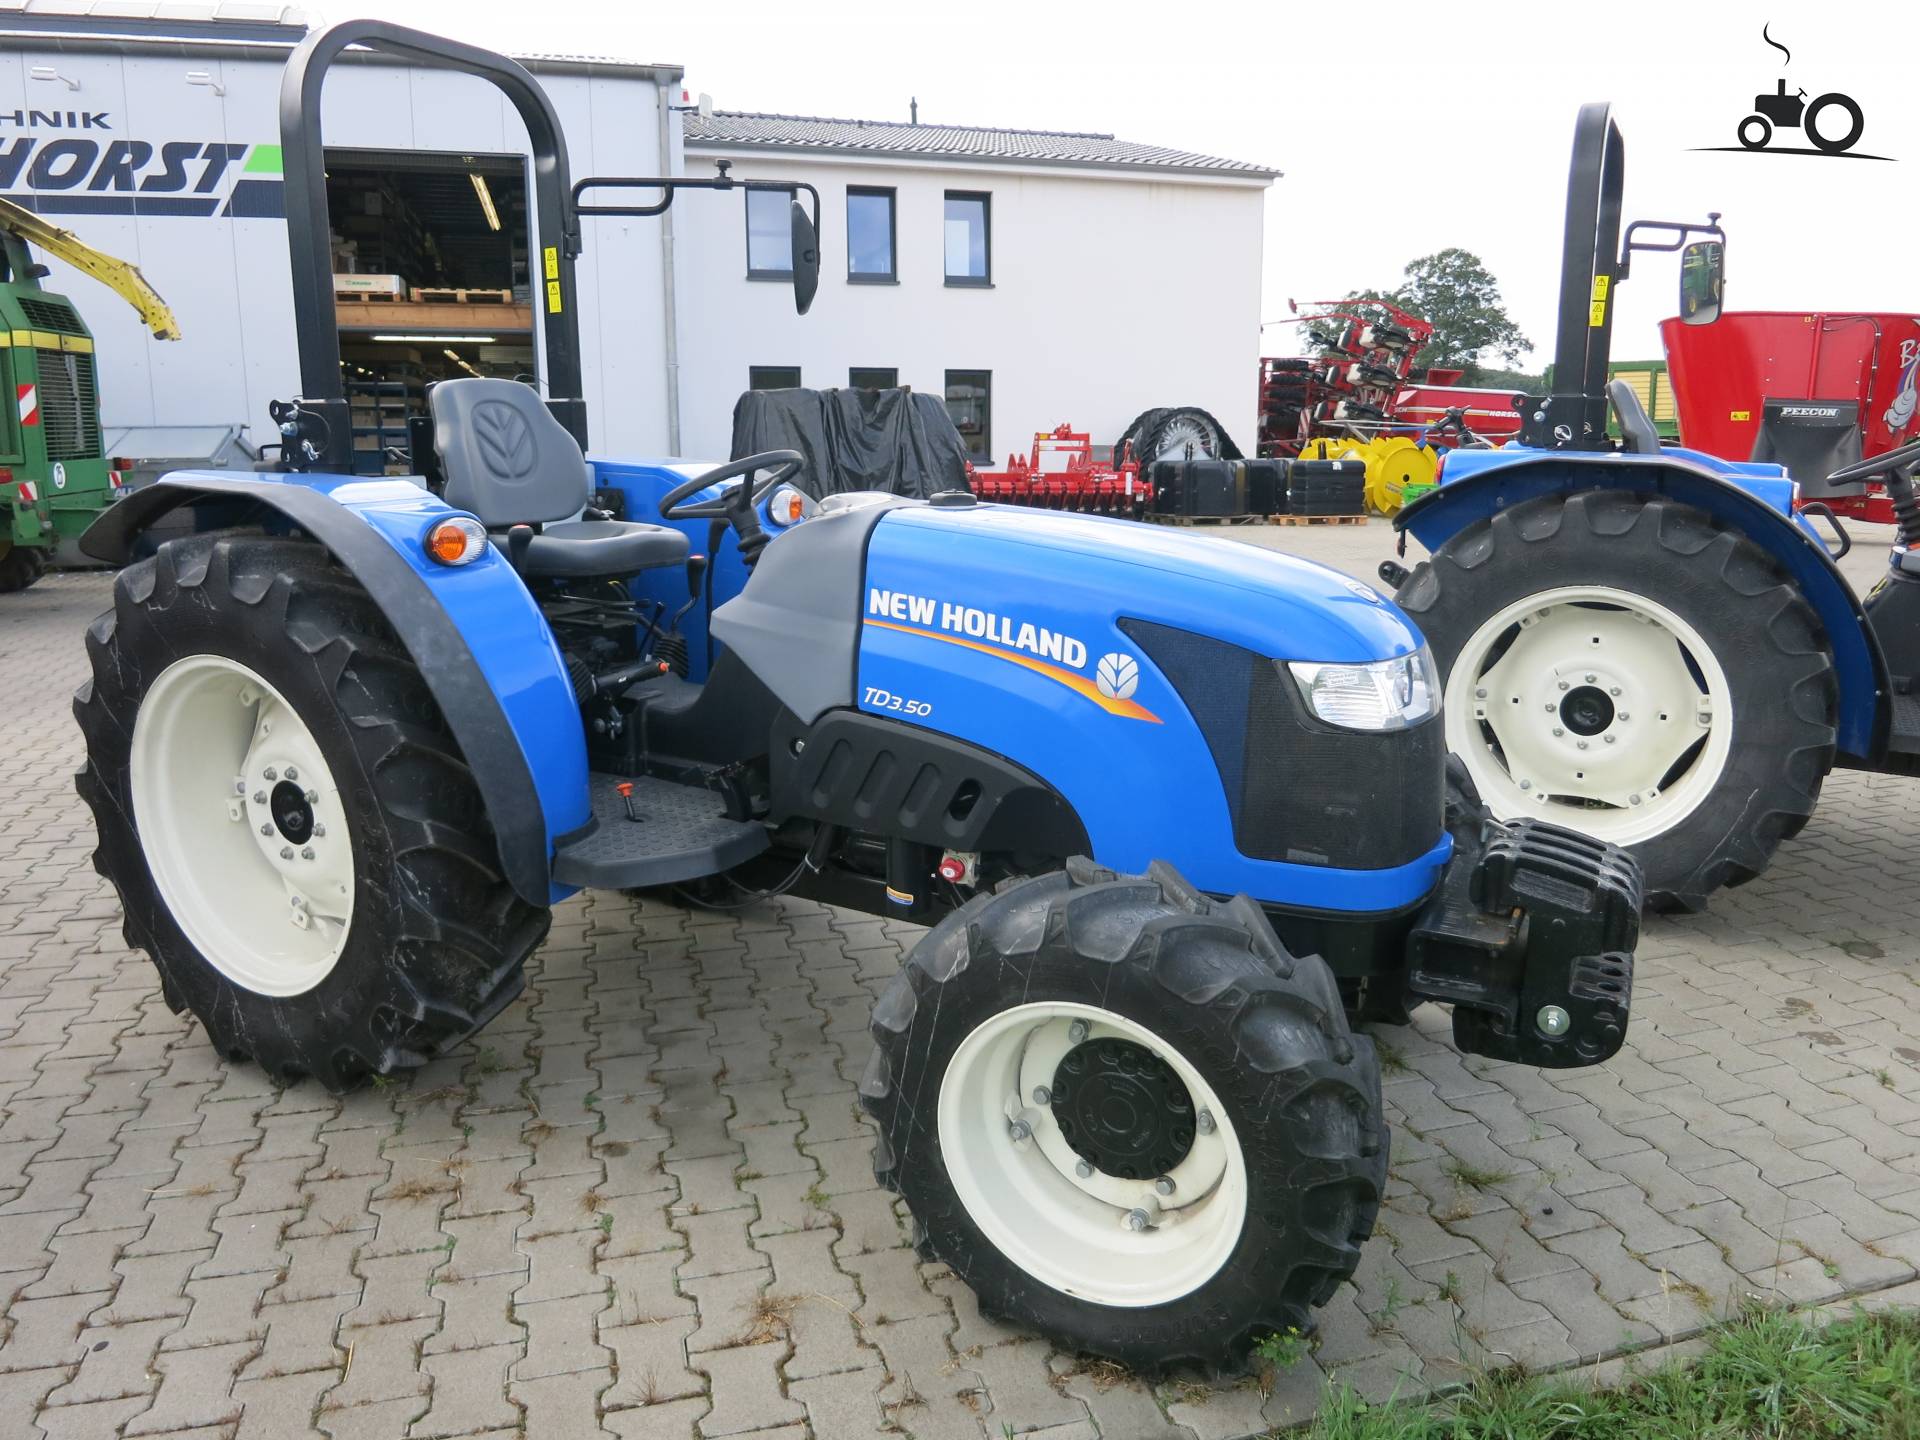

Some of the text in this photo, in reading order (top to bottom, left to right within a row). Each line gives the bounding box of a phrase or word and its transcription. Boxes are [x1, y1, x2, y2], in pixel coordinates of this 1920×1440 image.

[0, 137, 249, 193] HORST
[1780, 406, 1840, 418] PEECON
[869, 588, 1087, 669] NEW HOLLAND
[863, 687, 932, 717] TD3.50
